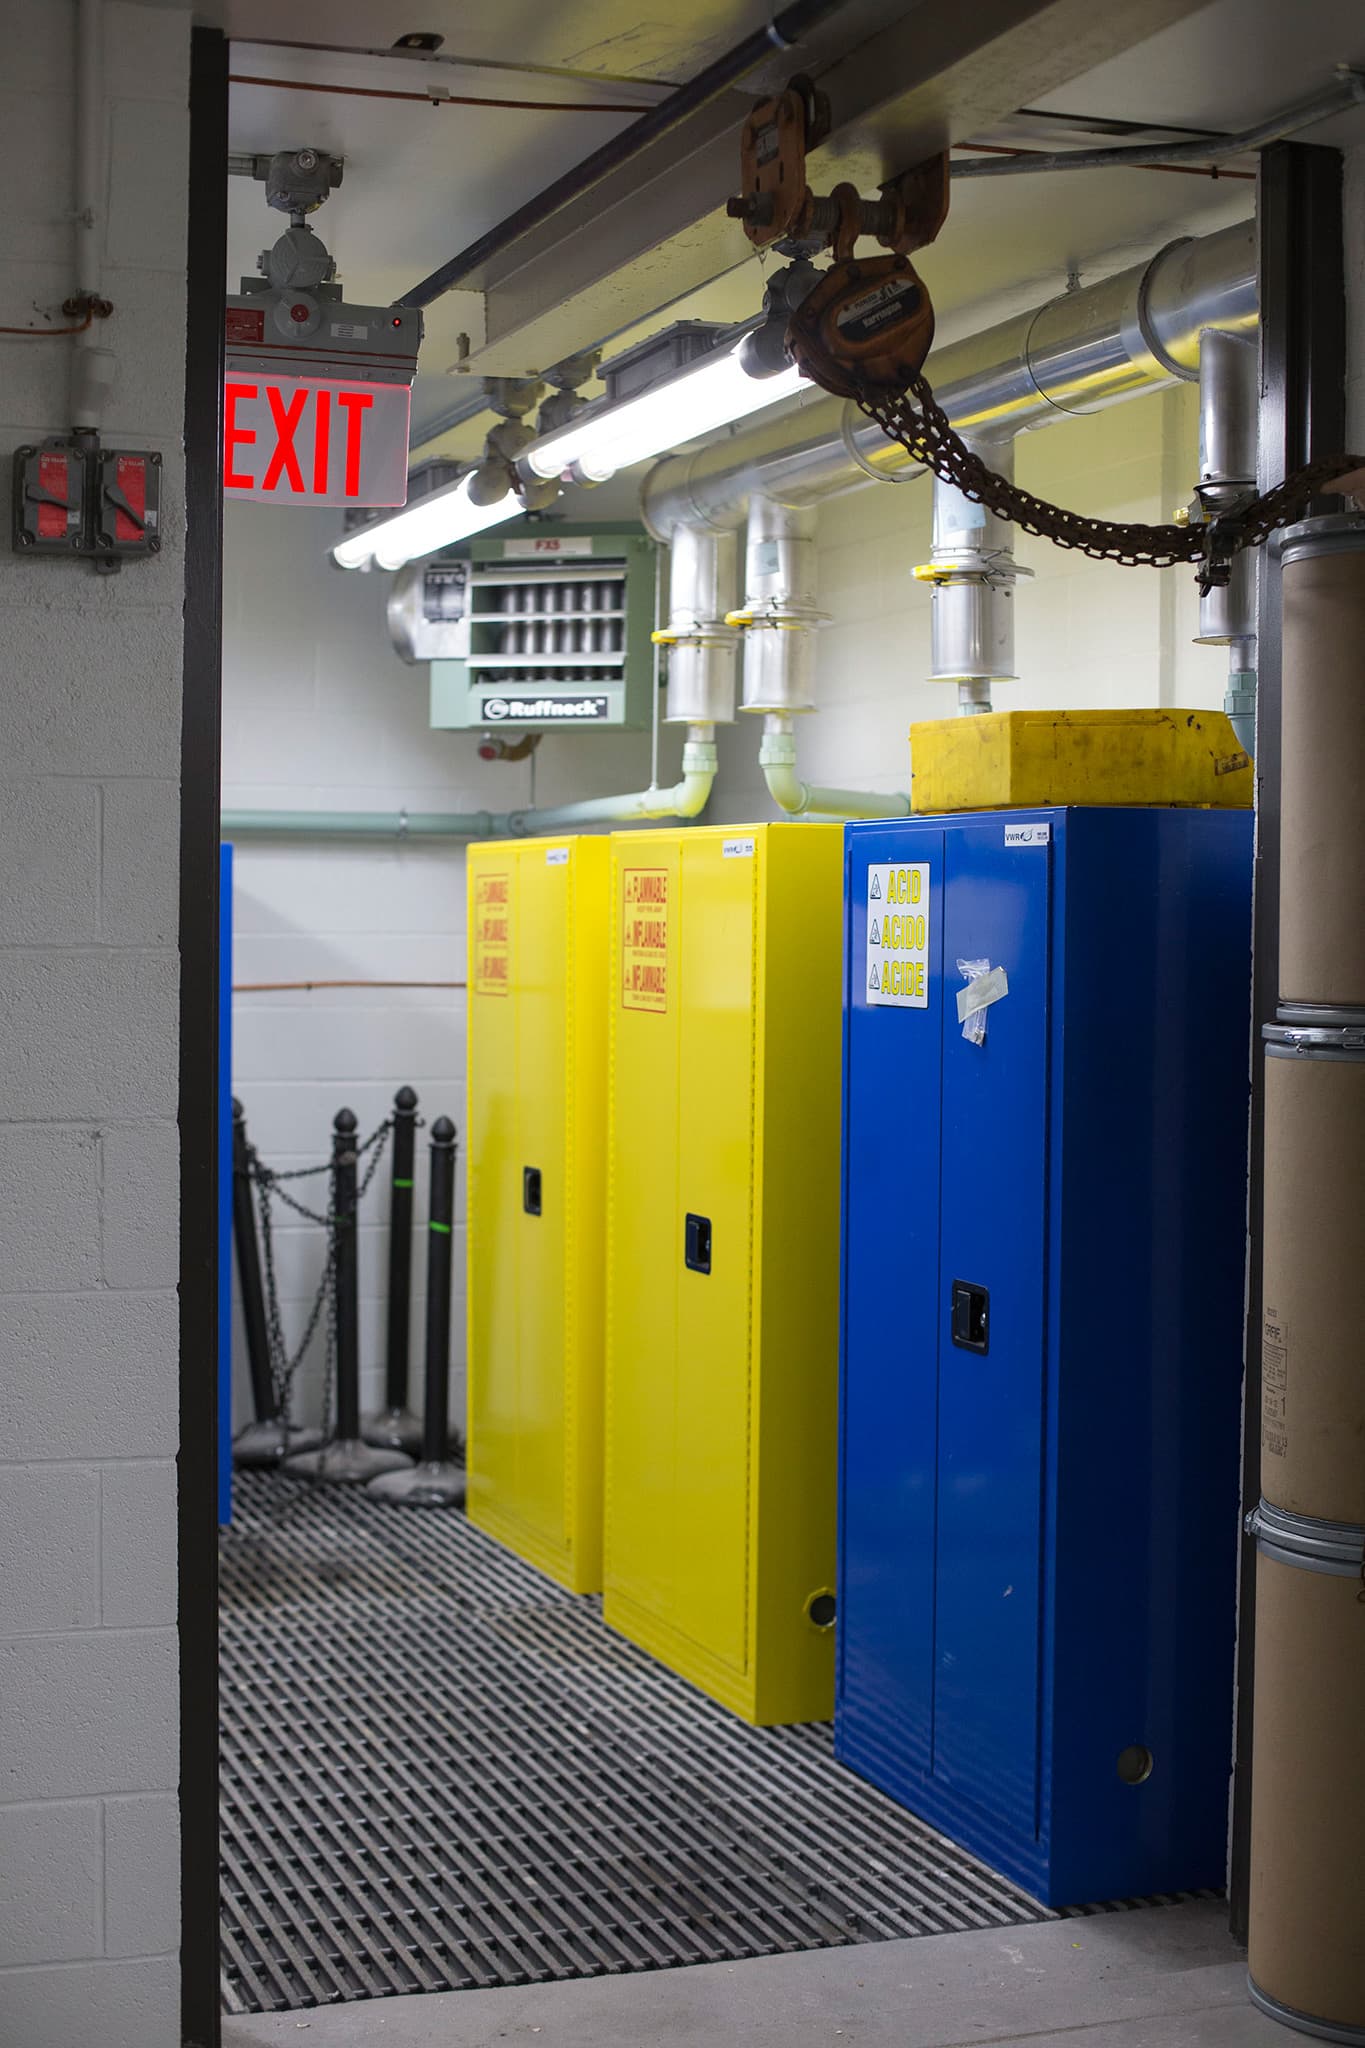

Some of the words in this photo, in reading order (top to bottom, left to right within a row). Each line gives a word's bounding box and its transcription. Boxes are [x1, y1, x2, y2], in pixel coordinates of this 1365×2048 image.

[223, 383, 374, 497] EXIT
[509, 700, 598, 717] Ruffneck
[1005, 833, 1020, 841] VWR
[886, 869, 921, 904] ACID
[881, 914, 925, 950] ACIDO
[881, 960, 924, 997] ACIDE
